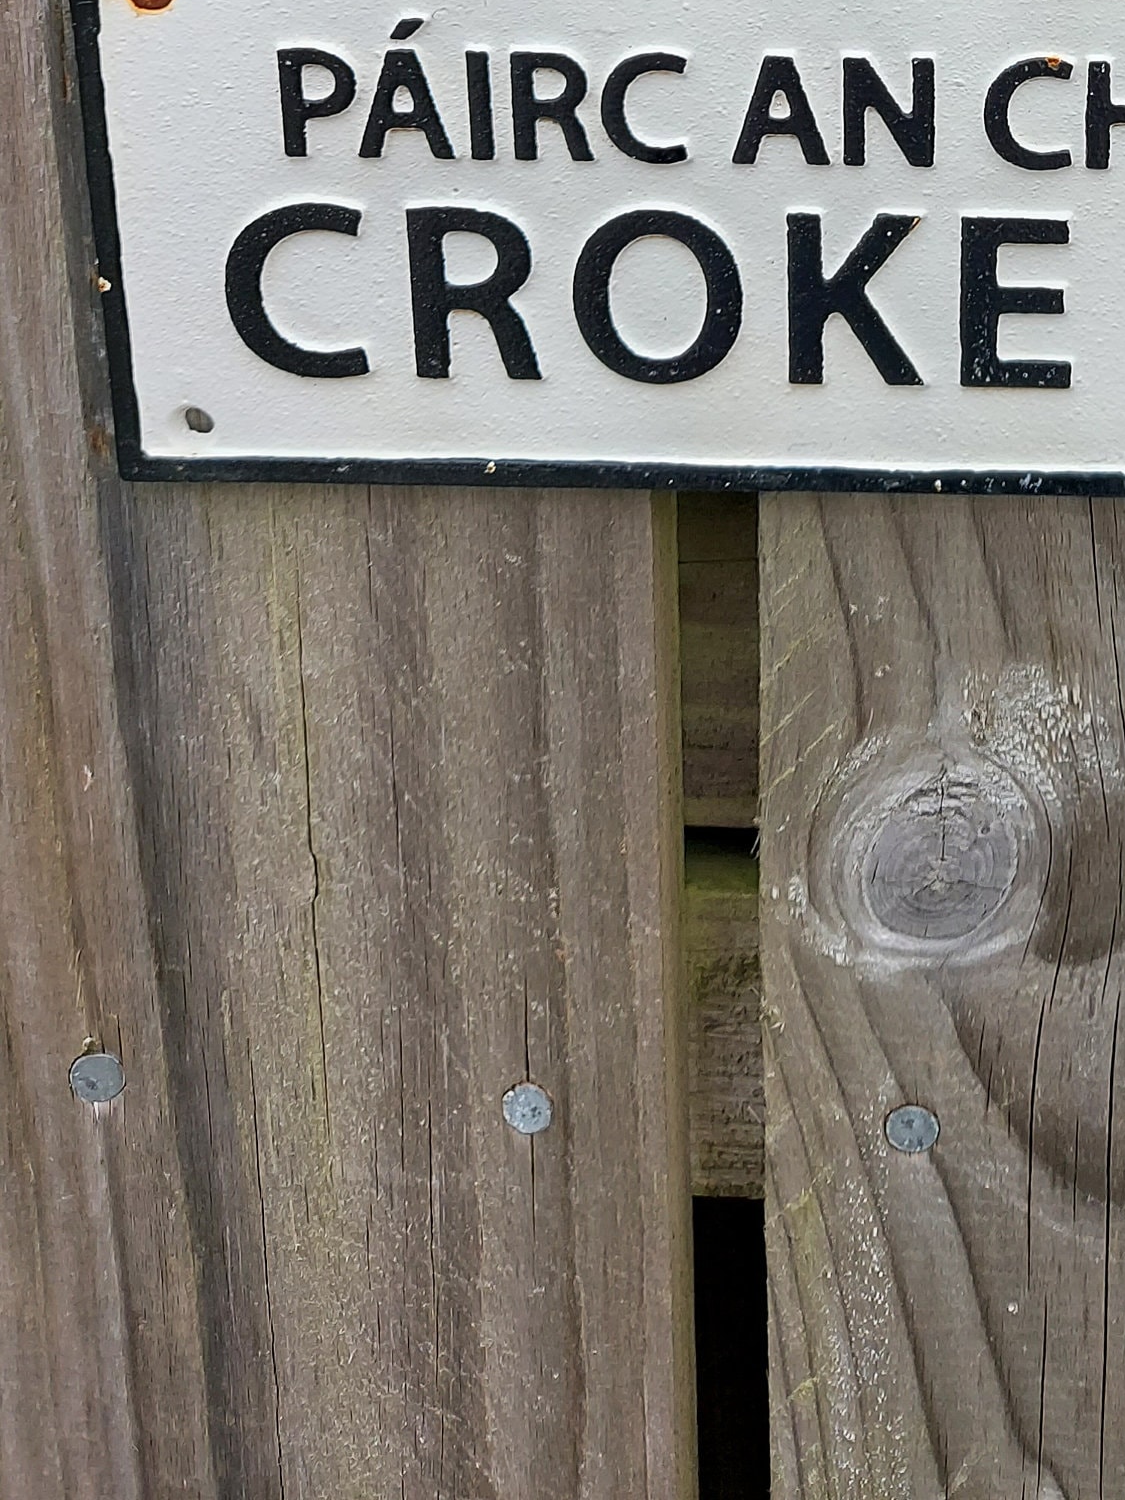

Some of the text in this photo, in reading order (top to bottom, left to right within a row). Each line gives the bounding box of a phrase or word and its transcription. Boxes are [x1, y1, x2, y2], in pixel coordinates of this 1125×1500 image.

[276, 16, 688, 166] PÁIRC
[731, 55, 937, 169] AN
[224, 202, 1073, 390] CROKE
